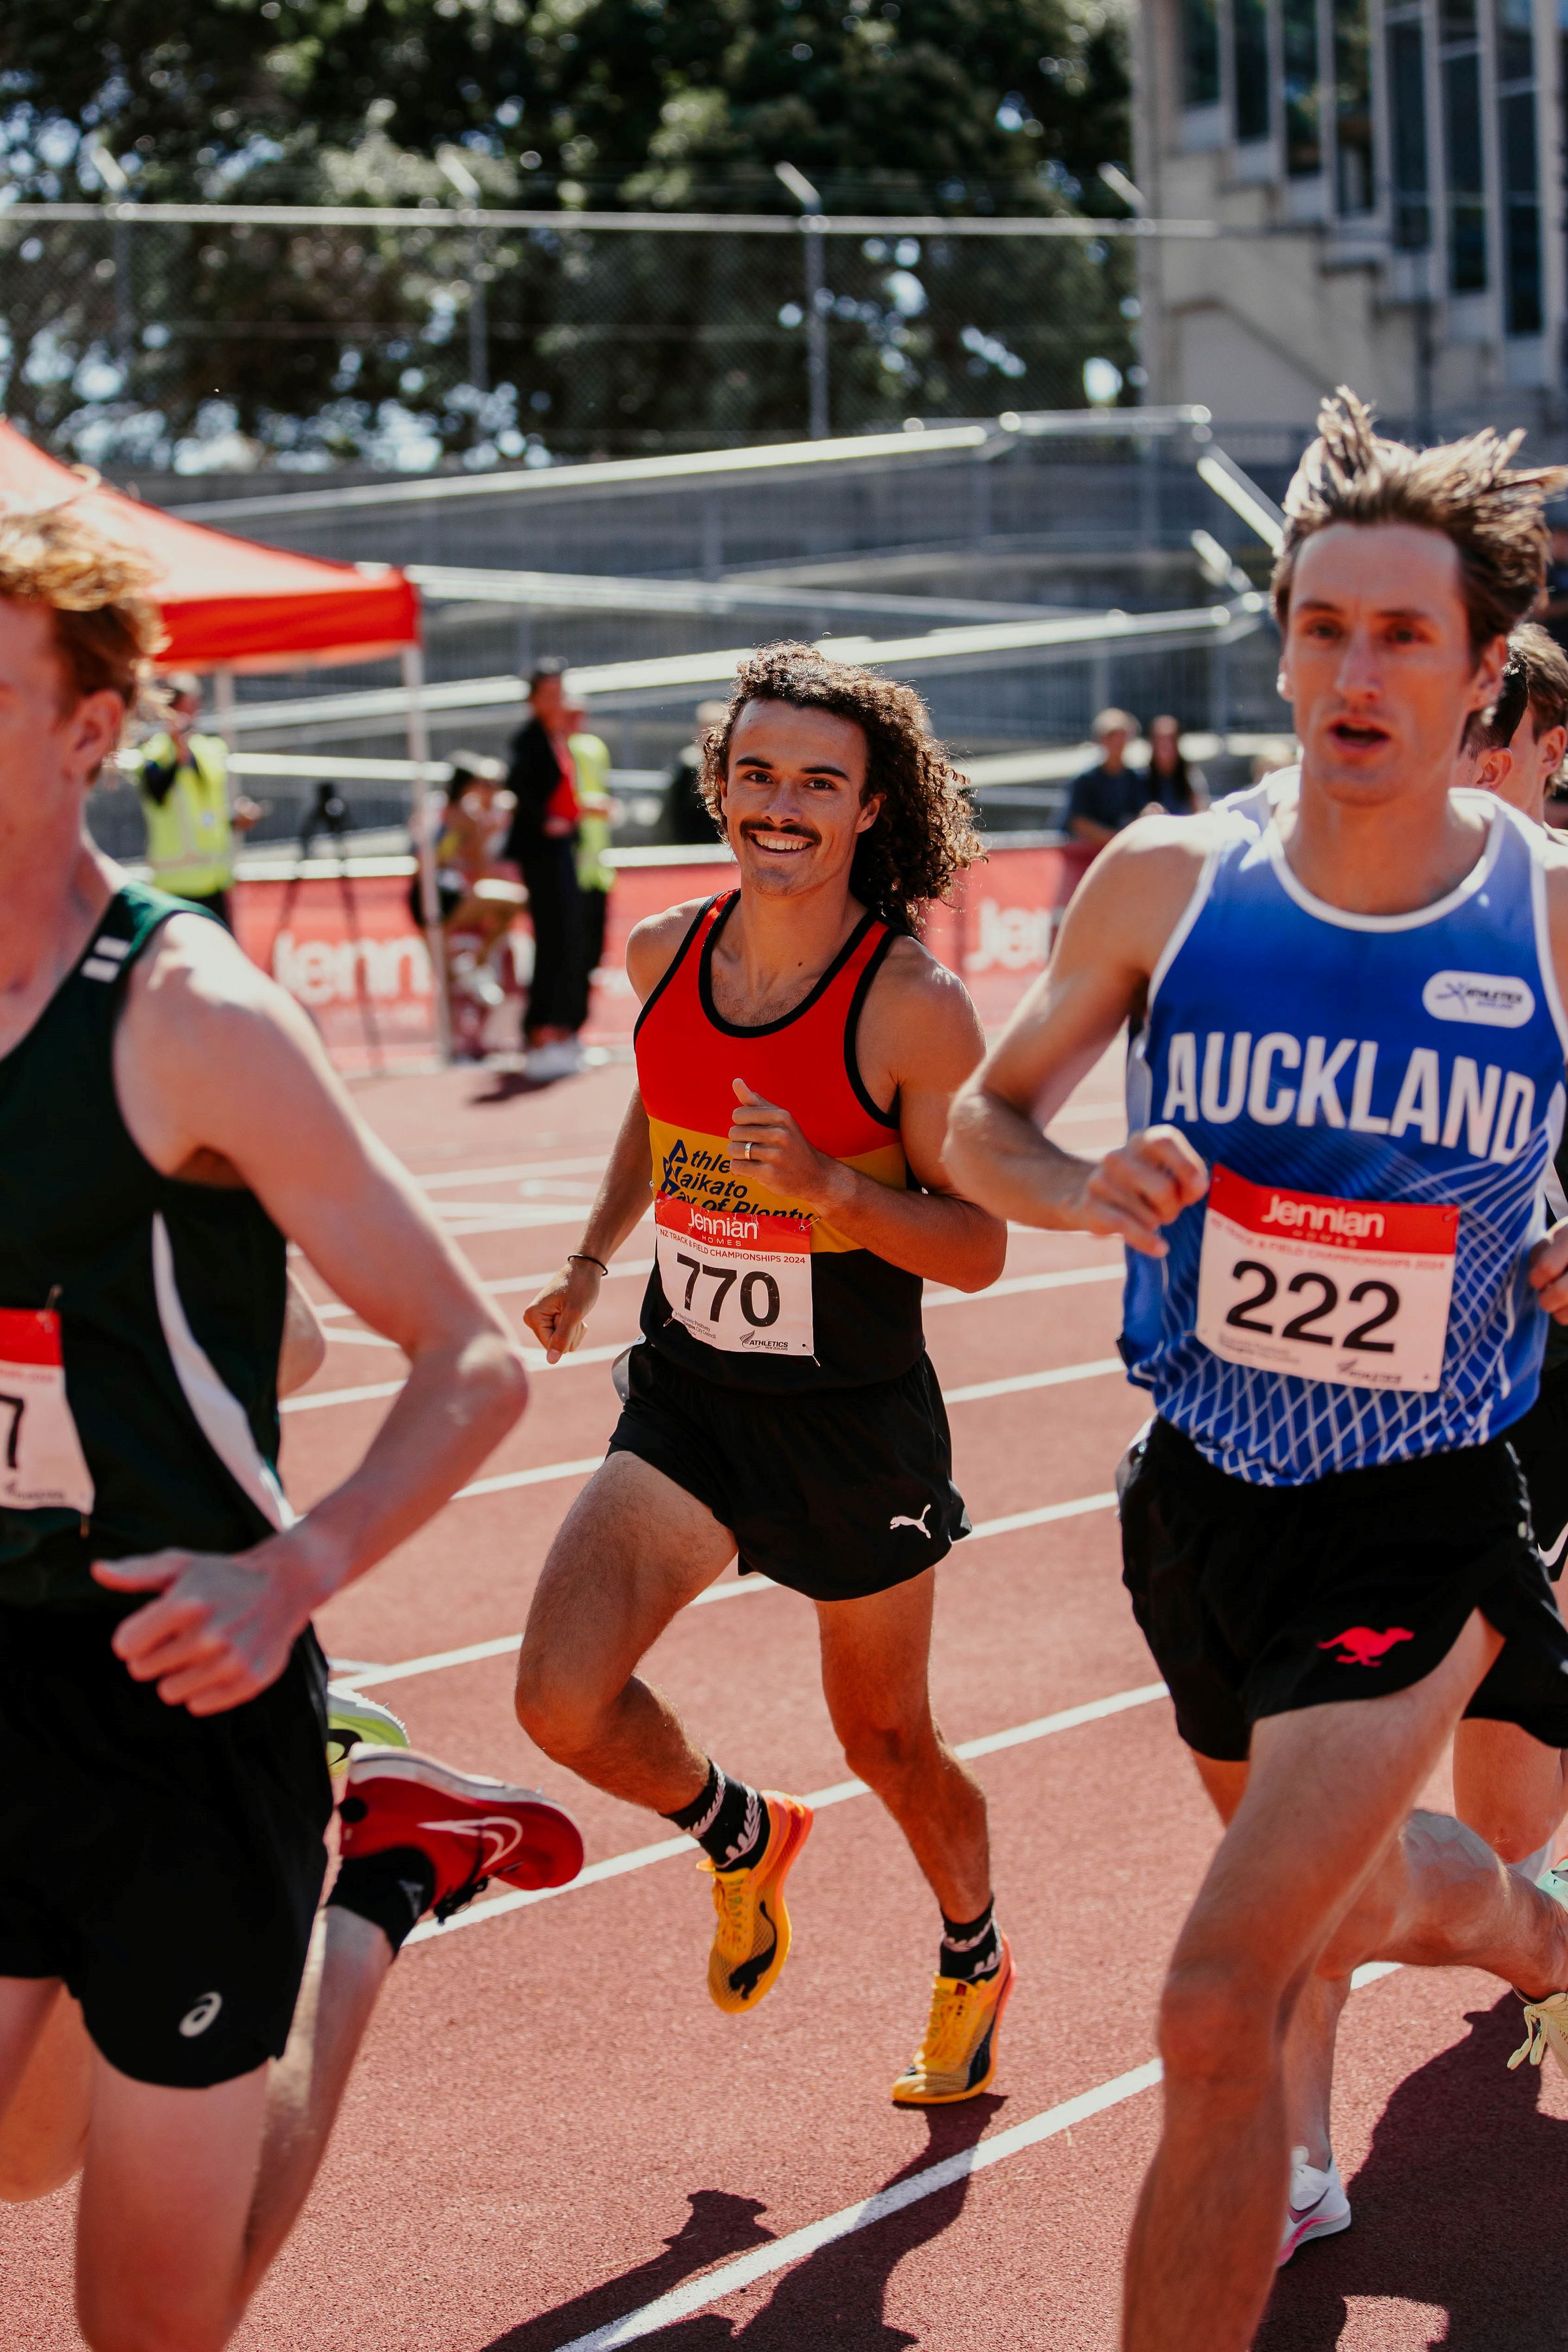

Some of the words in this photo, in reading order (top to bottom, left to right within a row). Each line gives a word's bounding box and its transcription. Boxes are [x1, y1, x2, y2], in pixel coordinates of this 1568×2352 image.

[1162, 1032, 1536, 1165] AUCKLAND
[668, 1139, 731, 1174] Athle
[688, 1208, 758, 1239] Jennian
[1261, 1194, 1385, 1238] Jennian
[660, 1228, 669, 1237] NZ
[670, 1232, 688, 1245] TRACK
[693, 1242, 709, 1254] FIELD
[710, 1249, 781, 1262] CHAMPIONSHIPS
[783, 1256, 806, 1264] 2024
[702, 1234, 742, 1247] HOMES
[676, 1252, 781, 1328] 770
[1226, 1260, 1401, 1354] 222
[749, 1339, 789, 1348] ATHLETICS
